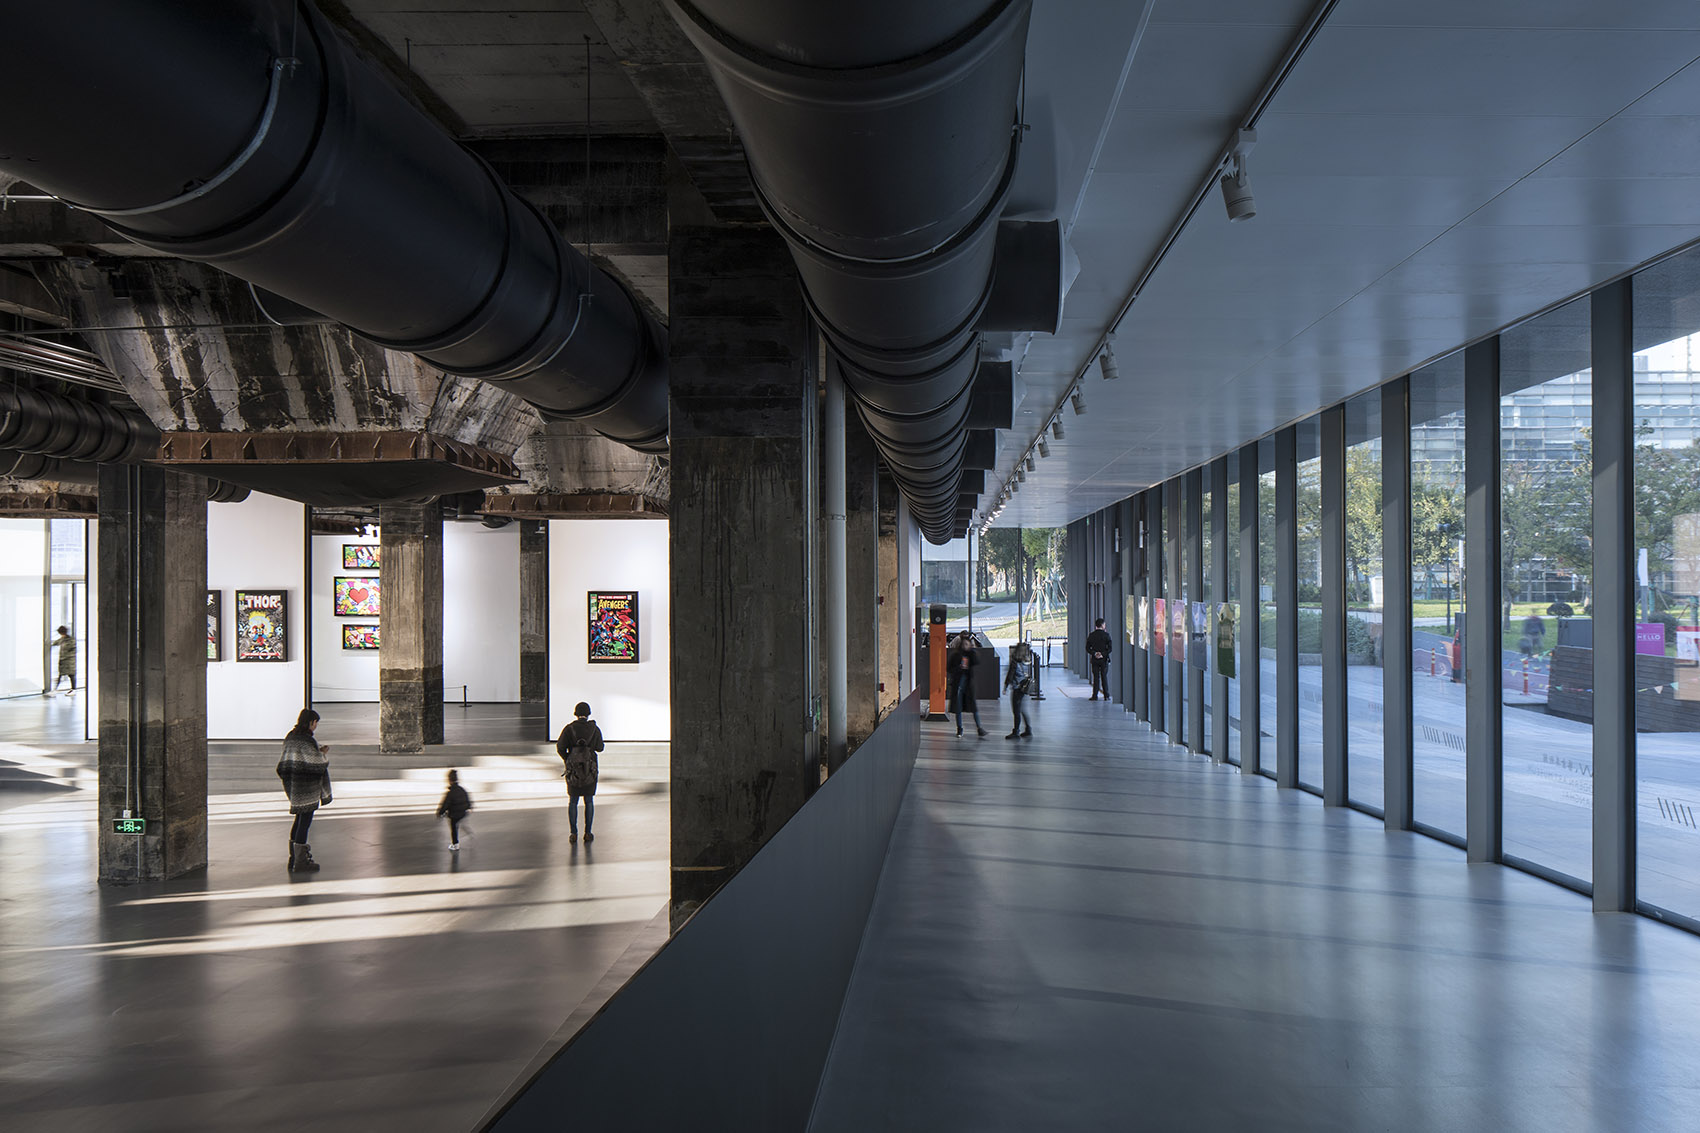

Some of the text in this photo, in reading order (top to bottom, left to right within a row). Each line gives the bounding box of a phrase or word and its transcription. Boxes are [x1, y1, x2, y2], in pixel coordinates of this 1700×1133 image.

[245, 595, 281, 609] THOR
[598, 599, 630, 609] AVENGERS
[1637, 633, 1661, 641] HELLO
